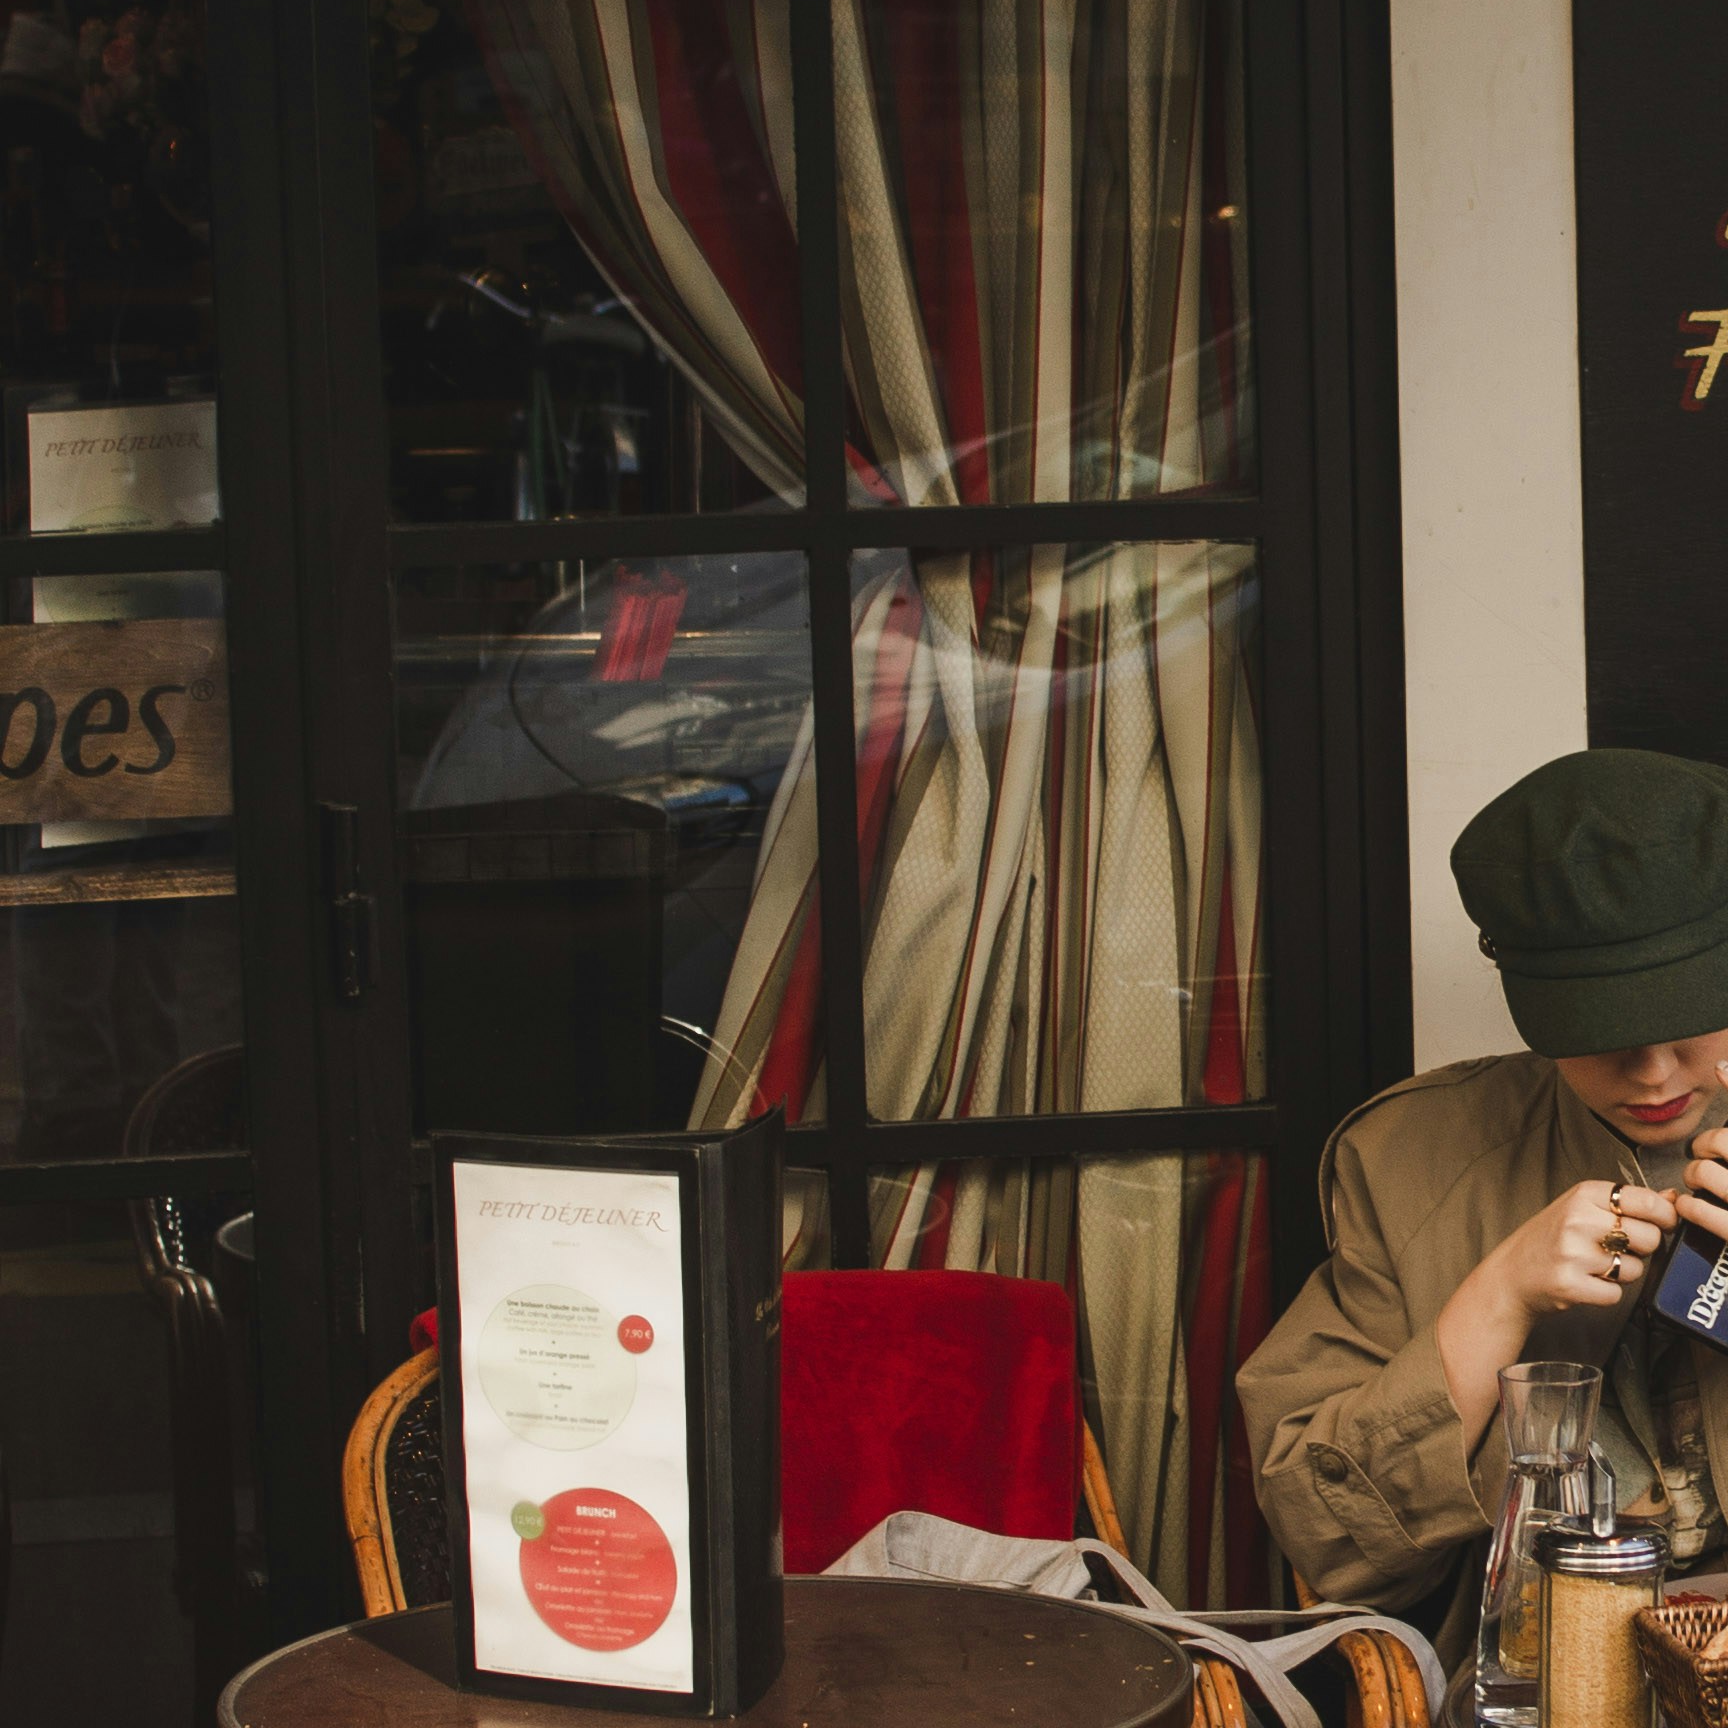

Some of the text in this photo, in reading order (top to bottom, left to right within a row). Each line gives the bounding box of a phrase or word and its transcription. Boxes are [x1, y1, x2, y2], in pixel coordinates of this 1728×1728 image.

[45, 435, 100, 458] PETIT
[478, 1200, 670, 1233] PETIT DÉJEUNER
[576, 1505, 616, 1519] BRUNCH
